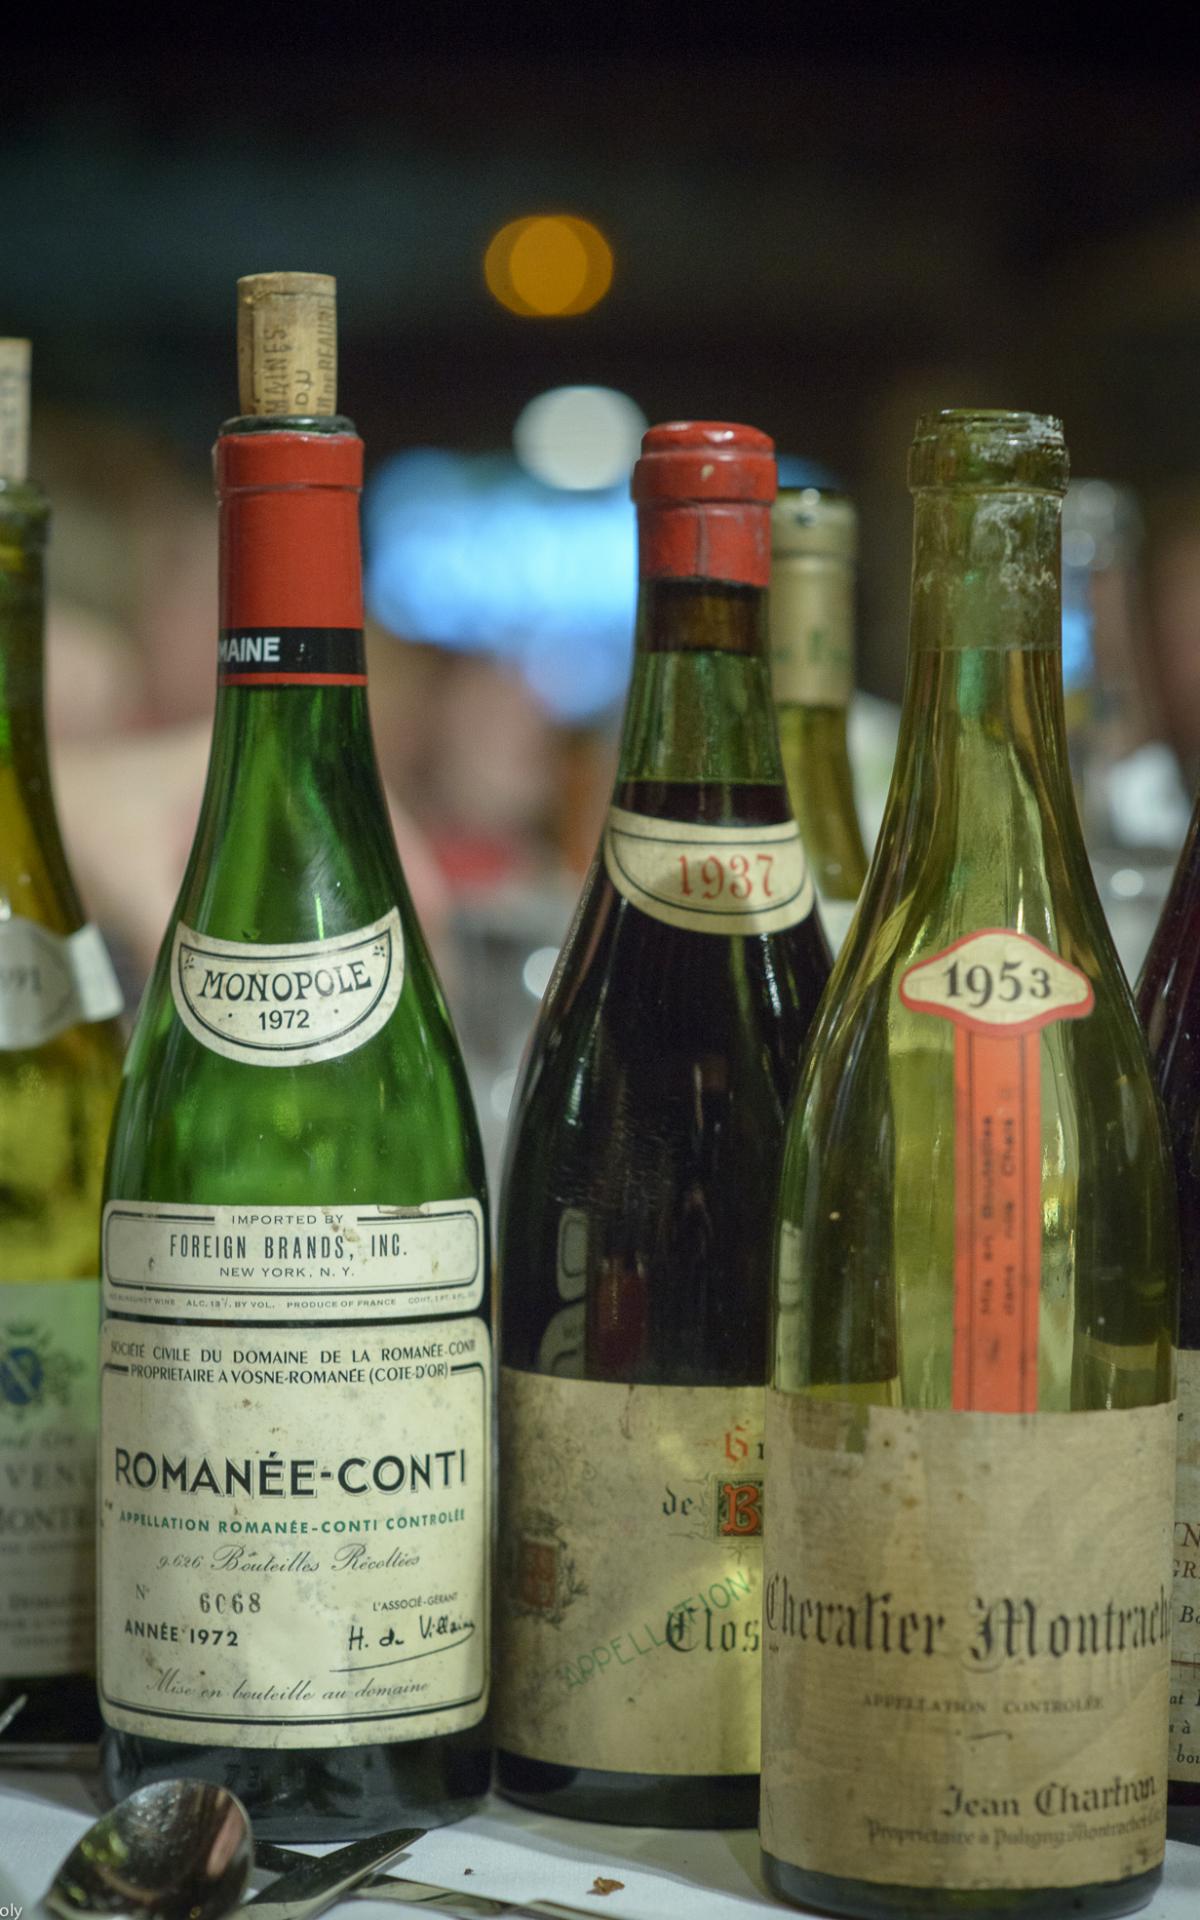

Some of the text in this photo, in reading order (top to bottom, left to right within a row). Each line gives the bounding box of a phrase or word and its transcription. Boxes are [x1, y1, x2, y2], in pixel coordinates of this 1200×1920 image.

[678, 853, 774, 900] 1937
[197, 960, 373, 1001] MONOPOLE
[943, 960, 1053, 1009] 1953
[258, 1009, 310, 1031] 1972
[231, 1213, 345, 1226] IMPORTED BY
[169, 1233, 408, 1261] FOREIGN BRANDS, INC.
[219, 1266, 355, 1279] NEW YORK, N. Y.
[234, 1300, 247, 1309] BY
[286, 1301, 338, 1309] PRODUCE
[340, 1300, 353, 1308] OF
[357, 1298, 397, 1308] FRANCE
[110, 1341, 145, 1359] SOCIÉTÉ
[152, 1346, 191, 1361] CIVILE
[201, 1348, 222, 1363] DU
[232, 1350, 309, 1365] DOMAINE
[320, 1349, 342, 1364] DE
[351, 1349, 371, 1363] LA
[130, 1363, 215, 1383] PROPRIETAIRE
[231, 1367, 366, 1384] VOSNE-ROMANÉE
[115, 1447, 466, 1498] ROMANÉE-CONTI
[662, 1483, 694, 1516] de
[119, 1507, 466, 1534] APPELLATION ROMANÉE-CONTI CONTROLÉE
[210, 1543, 320, 1573] Bouteilles
[331, 1542, 421, 1571] Récoltées
[560, 1569, 752, 1689] APPELLATION
[665, 1606, 760, 1652] Clos
[765, 1571, 946, 1657] Chevalier
[124, 1618, 239, 1647] ANNÉE 1972
[146, 1667, 429, 1701] Mise en bouteille au domaine
[862, 1694, 987, 1713] APPELLATION
[941, 1783, 1020, 1818] Jean
